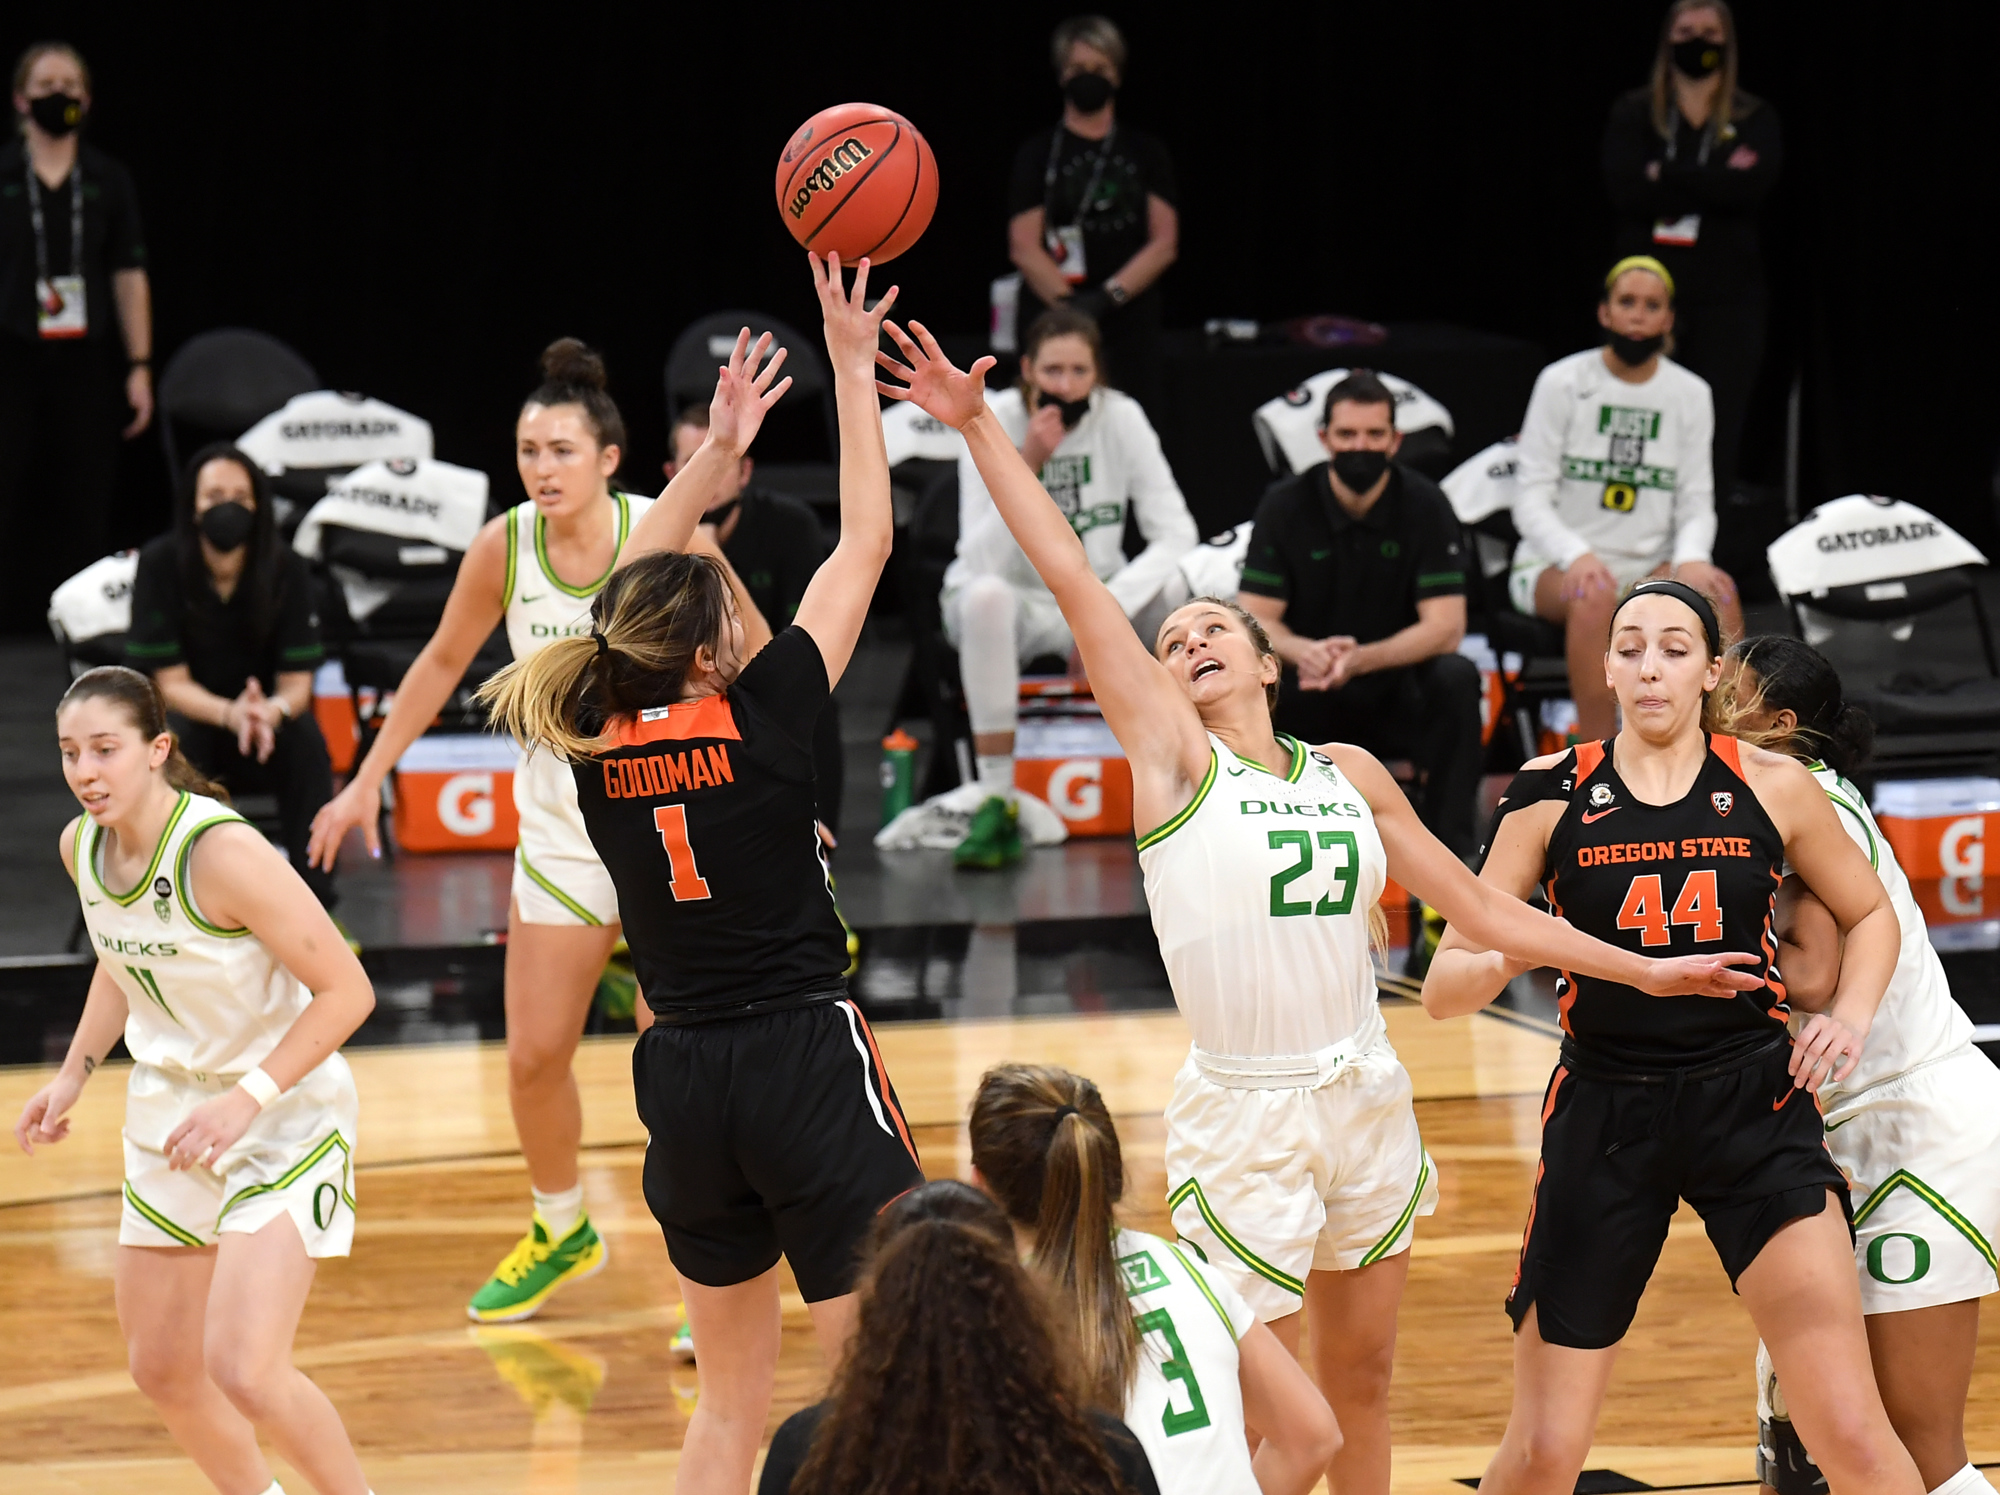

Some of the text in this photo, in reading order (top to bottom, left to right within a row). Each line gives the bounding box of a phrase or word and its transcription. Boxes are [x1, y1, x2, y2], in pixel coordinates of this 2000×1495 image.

[788, 137, 874, 219] Wilson
[1602, 407, 1656, 440] JUST
[1562, 457, 1676, 490] DUCKS
[1612, 437, 1641, 466] US
[1603, 482, 1637, 512] O
[1817, 522, 1941, 553] GATORADE
[603, 744, 734, 799] GOODMAN
[1047, 762, 1102, 821] G
[1561, 779, 1572, 791] KT
[437, 772, 495, 837] G
[1240, 801, 1361, 818] DUCKS
[1718, 801, 1729, 811] 12
[653, 803, 711, 901] 1
[1578, 837, 1751, 867] OREGON STATE
[1939, 816, 1985, 877] G
[1268, 830, 1359, 916] 23
[1616, 869, 1723, 947] 44
[98, 932, 178, 956] DUCKS
[125, 964, 185, 1029] 11
[1867, 1233, 1930, 1284] O
[1133, 1307, 1211, 1438] 3
